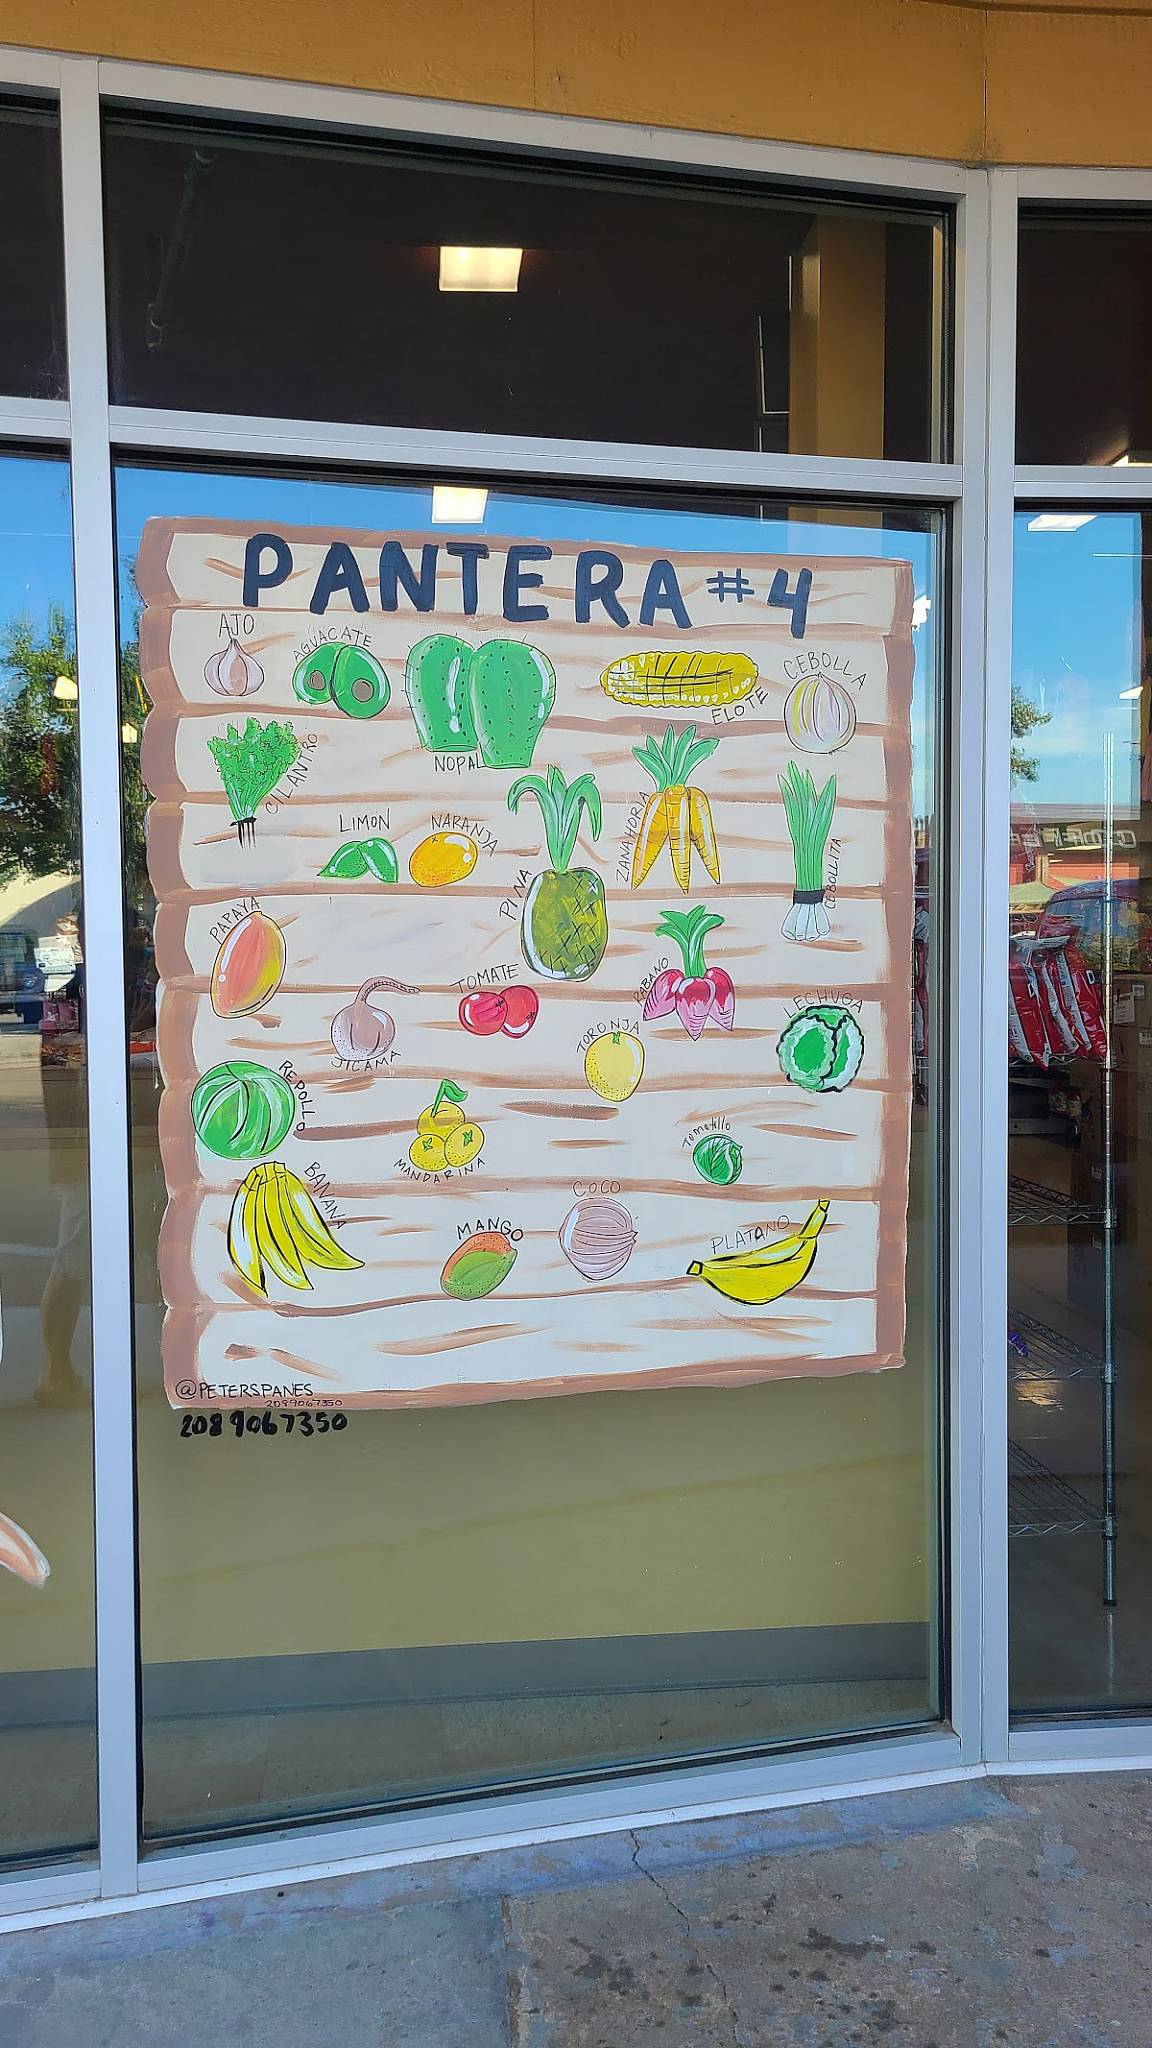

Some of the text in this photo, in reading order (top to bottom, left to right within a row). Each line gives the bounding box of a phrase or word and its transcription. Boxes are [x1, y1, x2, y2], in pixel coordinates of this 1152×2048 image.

[243, 533, 692, 629] PANTERA
[218, 613, 255, 638] AJO
[293, 626, 372, 662] AGUACATE
[783, 650, 867, 691] CEBOLLA
[711, 686, 769, 726] ELOTE
[264, 732, 318, 815] CILANTRO
[433, 753, 486, 776] NOPAL
[431, 813, 499, 859] NARANJA
[823, 836, 842, 910] CEBOLLITA
[209, 896, 260, 945] PAPAYA
[449, 963, 519, 994] TOMATE
[633, 956, 670, 1007] RABANO
[783, 987, 863, 1018] LECHUGA
[576, 1018, 640, 1054] TORONJA
[330, 1050, 402, 1072] JICAMA
[278, 1059, 316, 1132] REPOLLO
[393, 1156, 486, 1184] MANDARINA
[303, 1160, 347, 1230] BANANA
[572, 1179, 621, 1198] COCO
[456, 1216, 524, 1242] MANGO
[711, 1214, 790, 1254] PLATANO
[175, 1379, 314, 1399] @PETERSPANES
[264, 1399, 343, 1408] 2089067350
